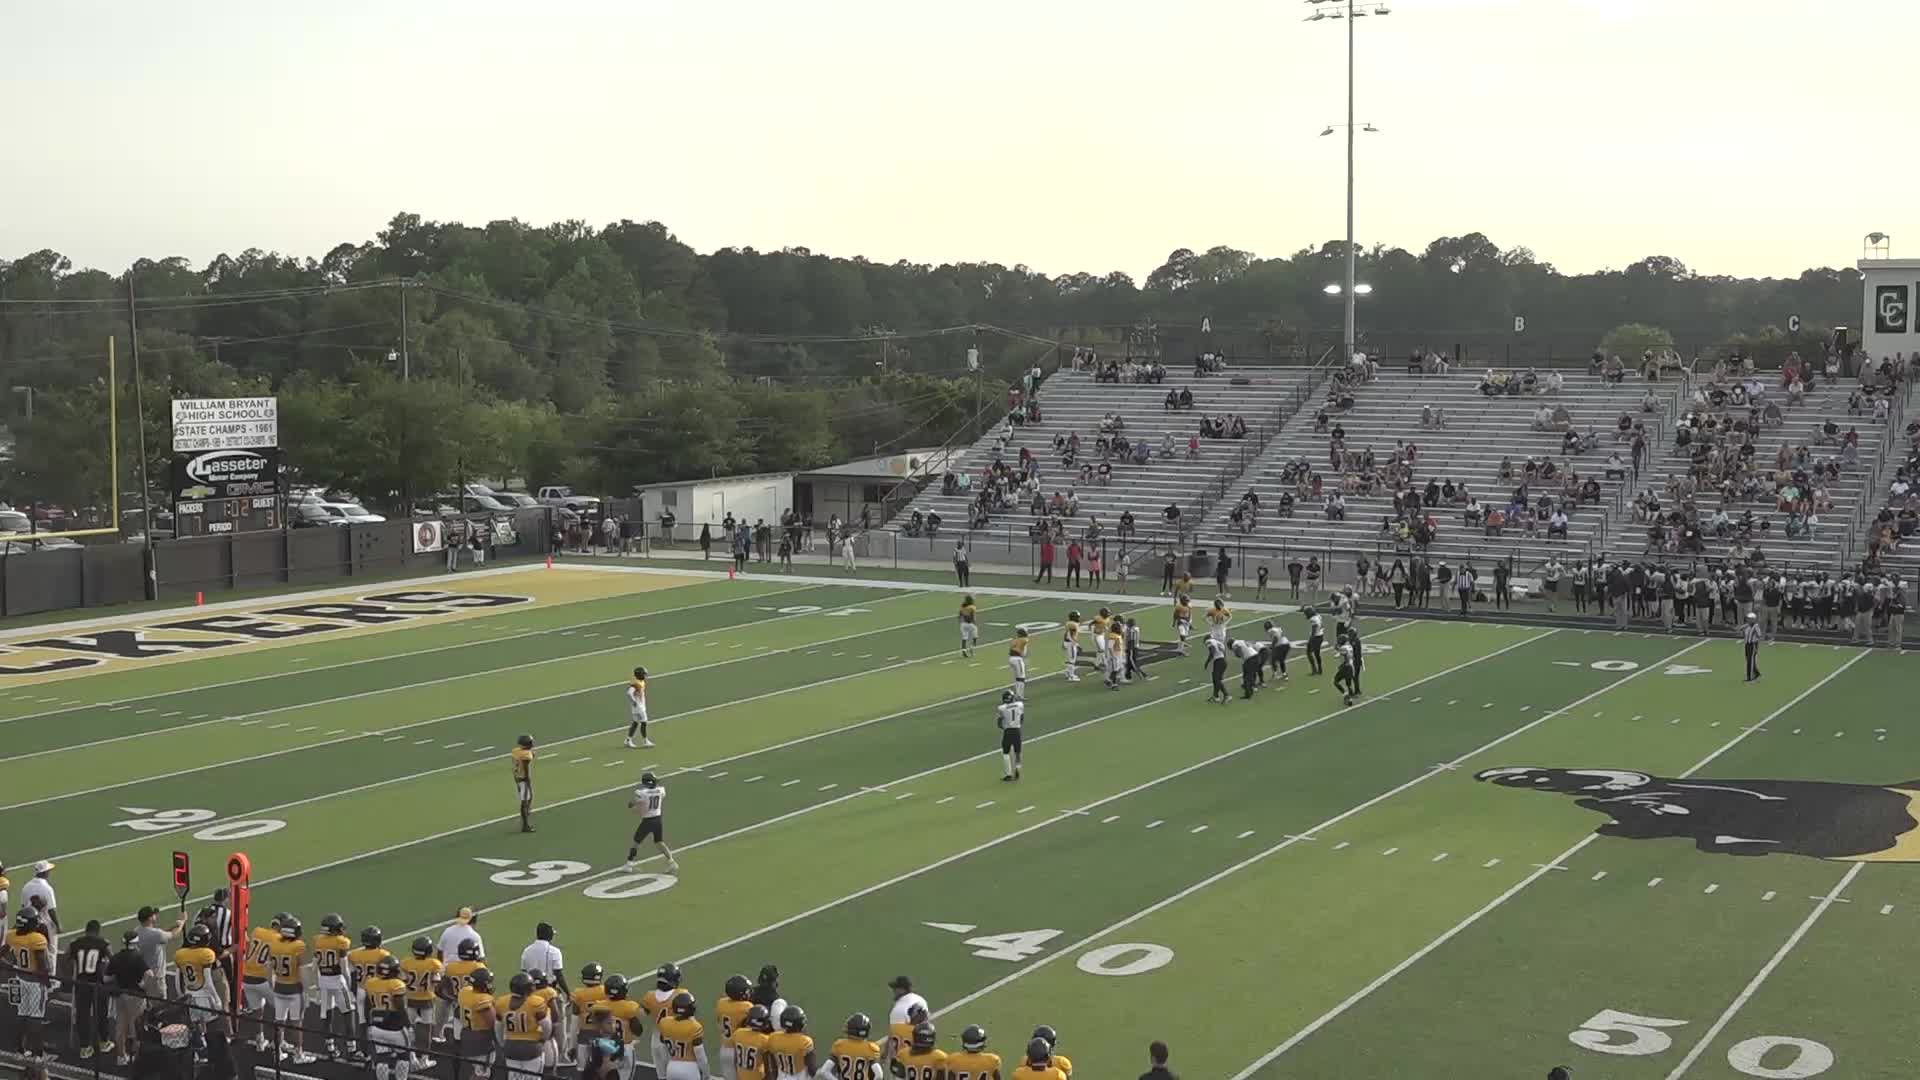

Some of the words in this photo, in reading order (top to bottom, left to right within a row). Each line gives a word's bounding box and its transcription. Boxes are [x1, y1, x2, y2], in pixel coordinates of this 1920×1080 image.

[1202, 316, 1211, 332] A
[1514, 316, 1525, 332] B
[1788, 315, 1801, 331] C
[180, 401, 226, 410] WILLIAM
[229, 399, 270, 409] BRYANT
[188, 411, 215, 420] HIGH
[218, 410, 262, 419] SCHOOL
[179, 425, 207, 436] STATE
[209, 424, 247, 434] CHAMPS
[195, 458, 268, 475] Lasseter
[178, 503, 204, 514] PACKERS
[252, 497, 275, 508] GUEST
[209, 522, 232, 532] PERIOD
[648, 794, 661, 811] 10
[174, 854, 187, 886] 2
[77, 949, 100, 974] 10
[407, 970, 430, 993] 24
[505, 1012, 528, 1034] 61
[736, 1044, 757, 1071] 36
